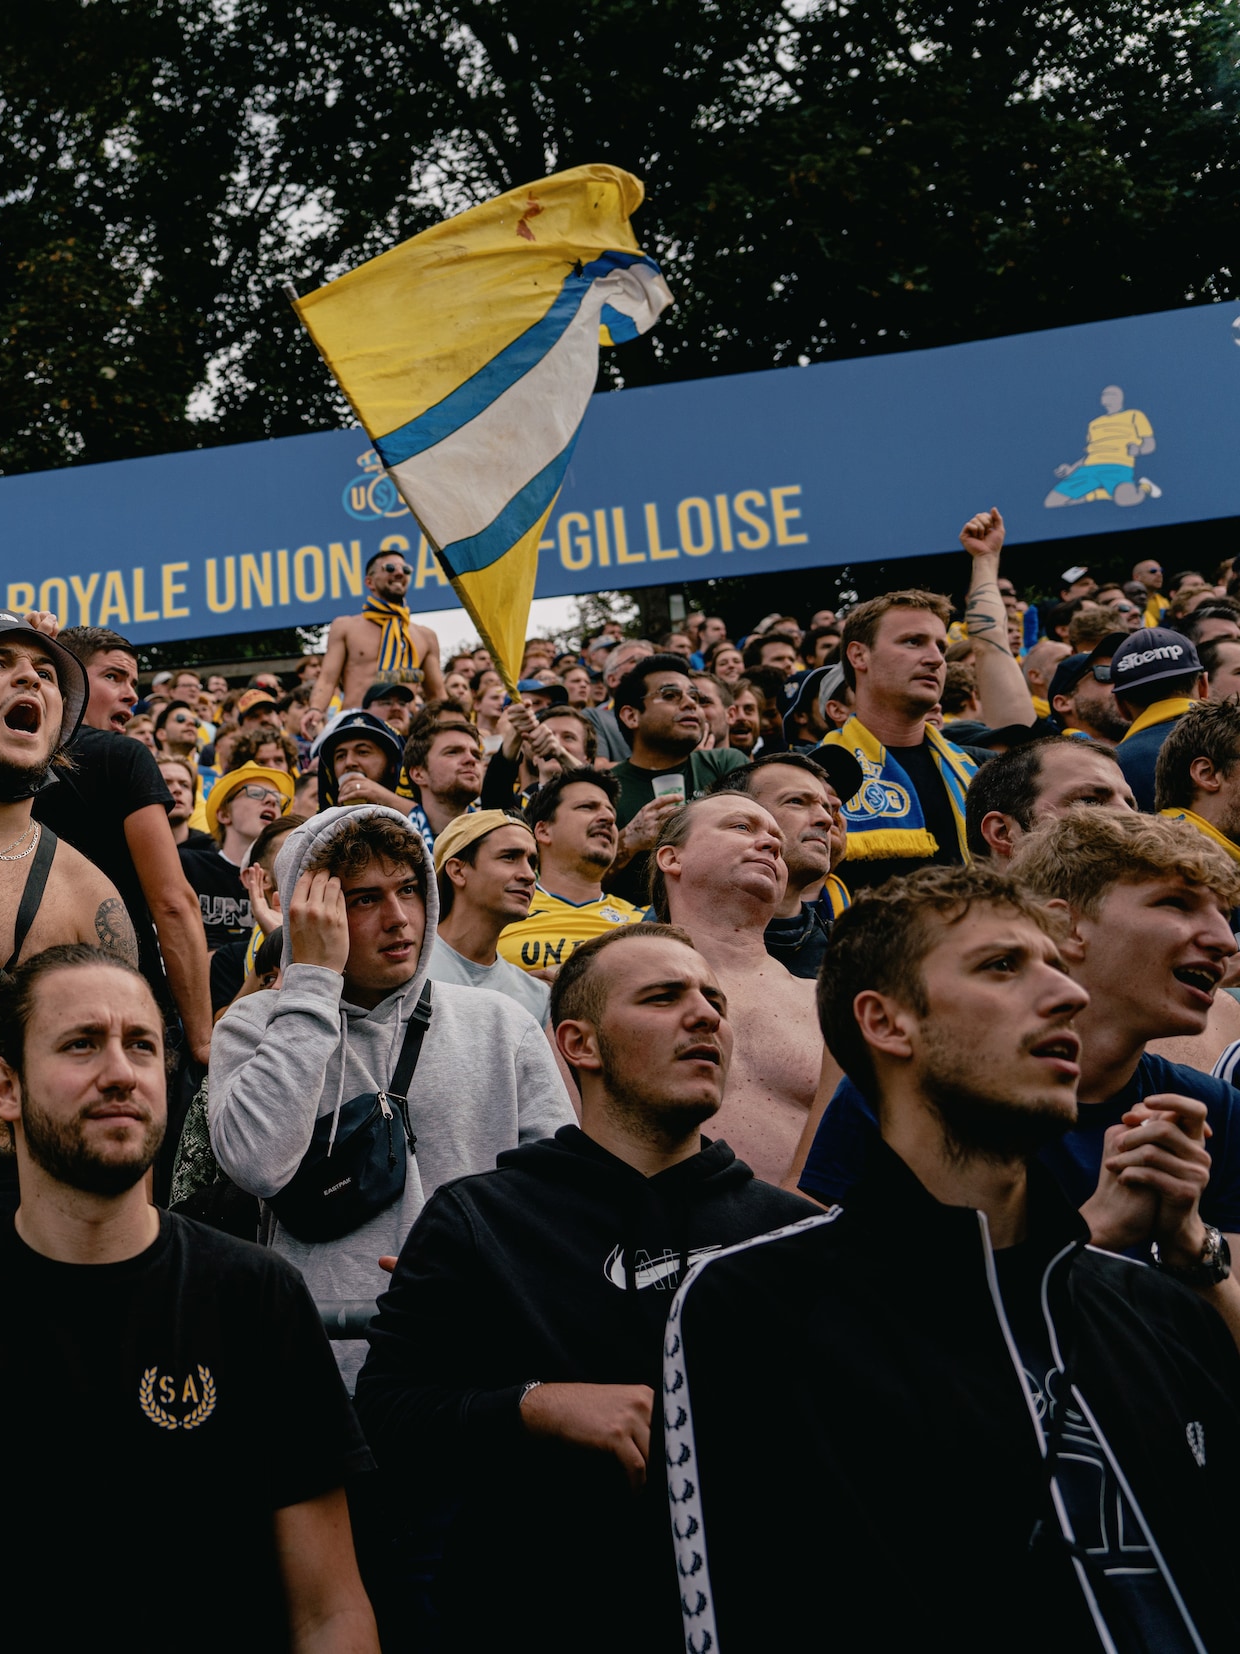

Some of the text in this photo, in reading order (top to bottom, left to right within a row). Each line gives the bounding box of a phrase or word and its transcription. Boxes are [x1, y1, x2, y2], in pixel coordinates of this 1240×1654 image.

[6, 560, 191, 631] ROYALE
[204, 539, 364, 615] UNION
[323, 1176, 352, 1196] EASTPAK
